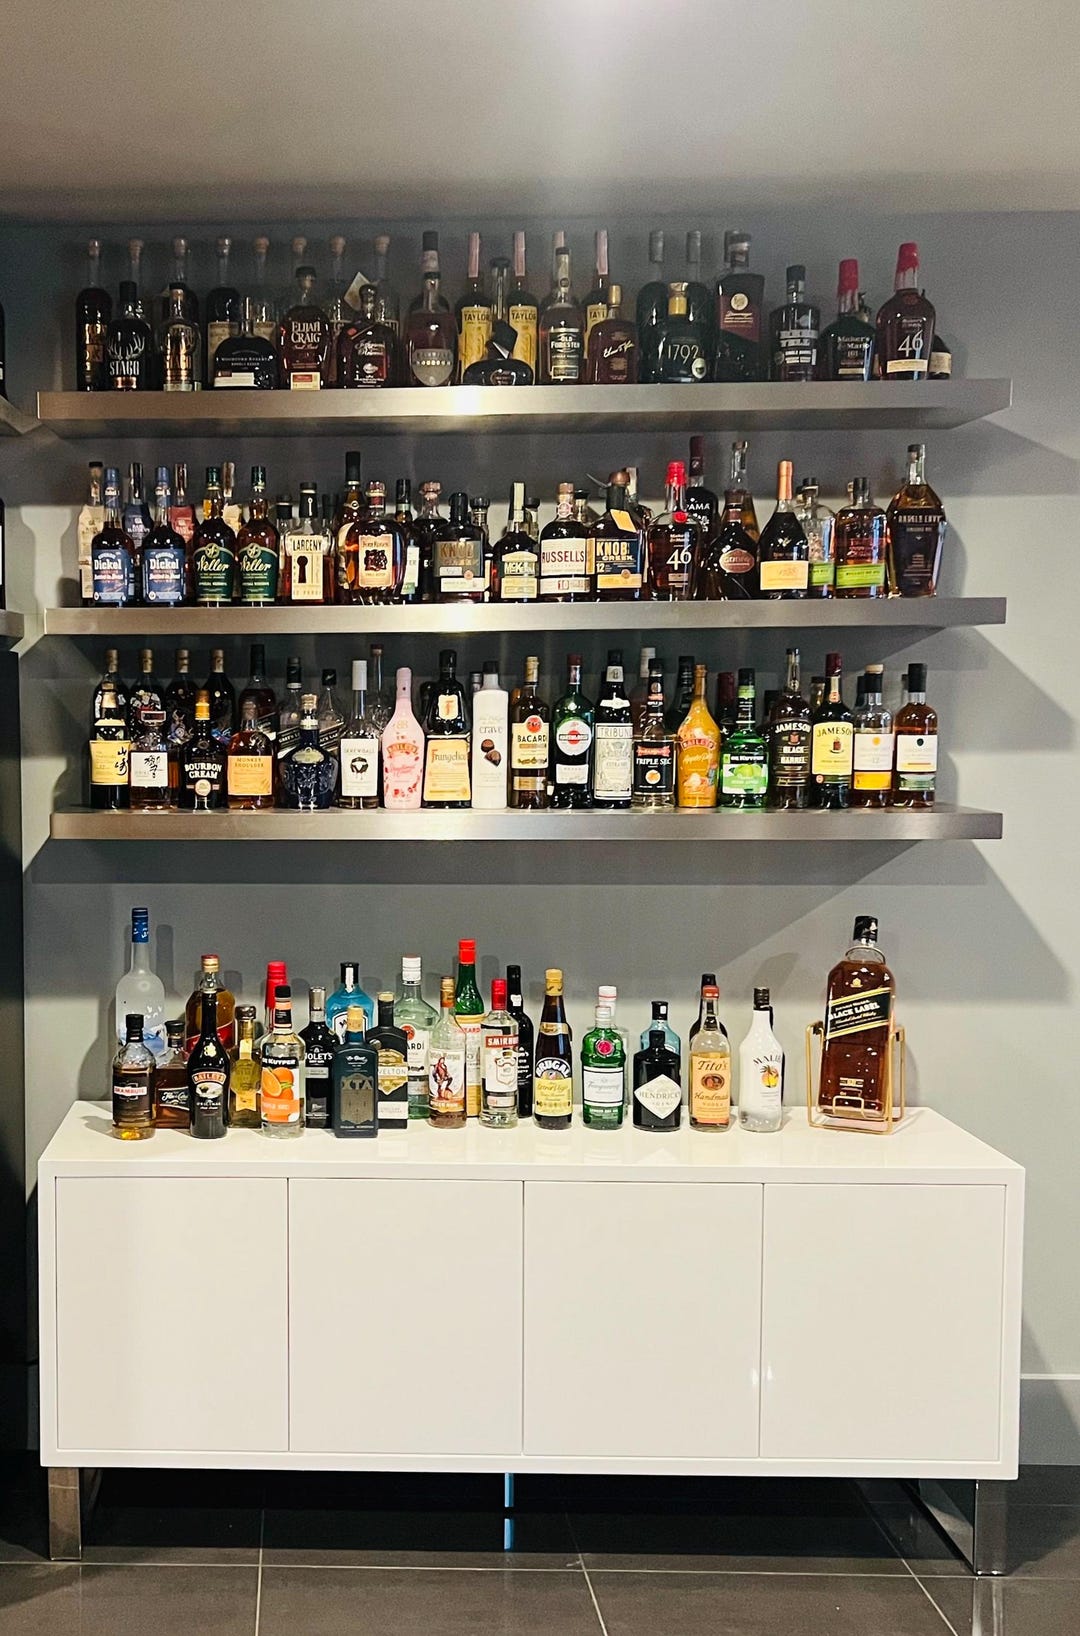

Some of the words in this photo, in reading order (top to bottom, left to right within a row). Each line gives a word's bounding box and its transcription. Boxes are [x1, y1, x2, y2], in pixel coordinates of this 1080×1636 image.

[292, 321, 321, 332] ELIJAH
[291, 332, 321, 344] CRAIG
[898, 330, 923, 357] 46
[668, 344, 699, 365] 1792
[293, 539, 323, 551] LARCENY
[441, 542, 474, 558] KNOB
[596, 541, 627, 557] KNOB
[666, 544, 692, 571] 46
[94, 559, 122, 570] Dickel
[149, 558, 179, 570] Dickel
[596, 563, 605, 573] 12
[775, 722, 811, 734] JAMESON
[517, 735, 547, 743] BACARD
[184, 762, 222, 772] BOURBON
[189, 771, 218, 779] CREAM
[854, 1002, 881, 1014] LABEL
[536, 1061, 571, 1078] BRUGAL
[698, 1060, 728, 1071] Tito's
